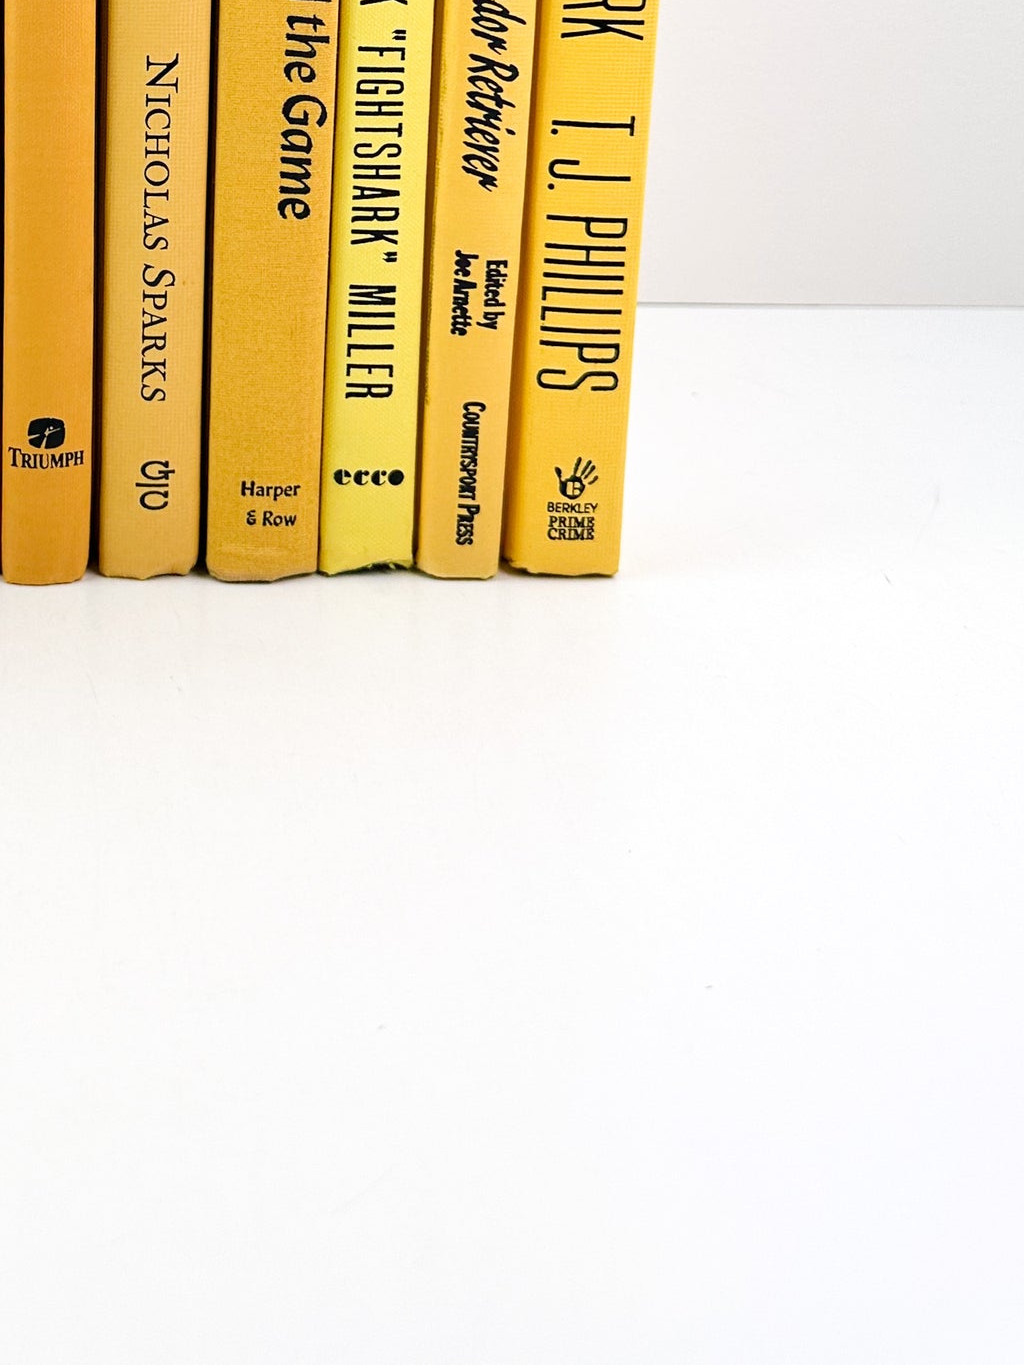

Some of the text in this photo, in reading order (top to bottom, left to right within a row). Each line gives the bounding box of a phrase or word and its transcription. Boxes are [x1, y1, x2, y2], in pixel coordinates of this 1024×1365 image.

[283, 13, 331, 84] the
[277, 94, 328, 220] Game
[350, 29, 407, 263] "FIGHTSHARK"
[461, 53, 520, 193] Retriever
[140, 52, 180, 402] NICHOLAS SPARKS
[450, 249, 481, 337] Joe Arnette
[476, 259, 509, 330] Edited by
[536, 214, 629, 392] PHILLIPS
[344, 284, 397, 400] MILLER
[7, 446, 84, 470] TRIUMPH
[240, 480, 301, 502] Harper
[333, 468, 405, 487] ecco
[455, 401, 487, 546] COUNTRYSPORT PRESS
[246, 509, 297, 527] & Row
[546, 501, 598, 514] BERKLEY
[546, 527, 596, 541] CRIME
[547, 515, 596, 528] PRIME
